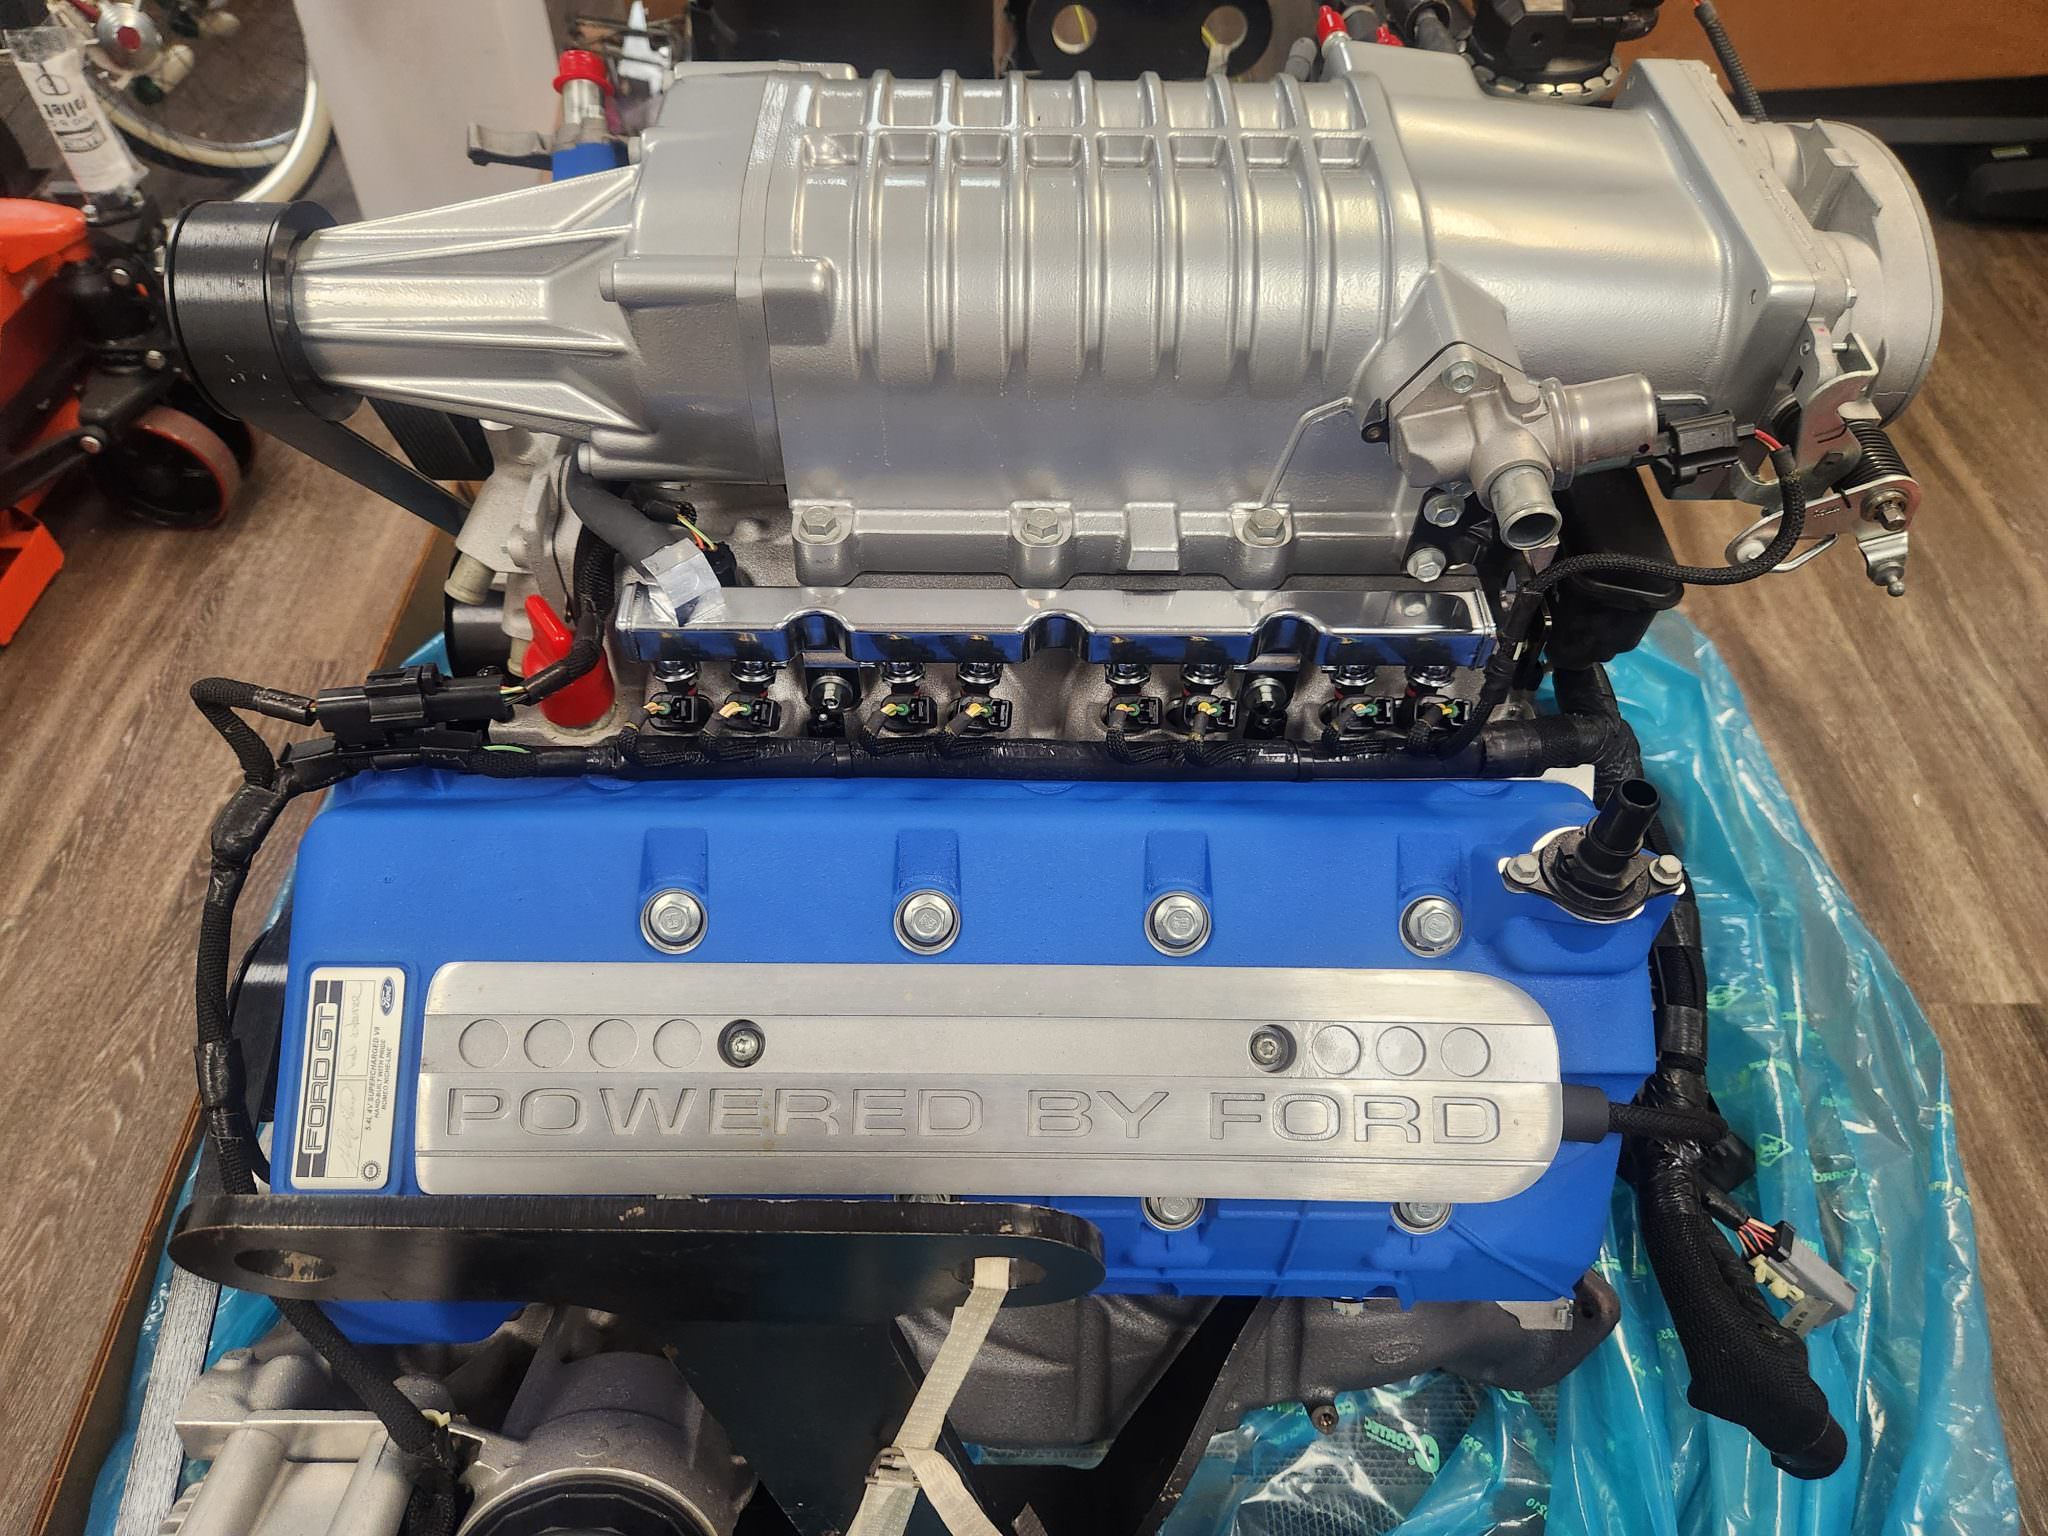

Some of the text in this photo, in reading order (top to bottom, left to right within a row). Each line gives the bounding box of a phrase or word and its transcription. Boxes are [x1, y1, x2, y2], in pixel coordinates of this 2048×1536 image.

[304, 1005, 335, 1151] FORD GT
[367, 1037, 380, 1102] SUPERCHARGED
[377, 1060, 385, 1077] WITH
[445, 1087, 1501, 1145] POWERED BY FORD
